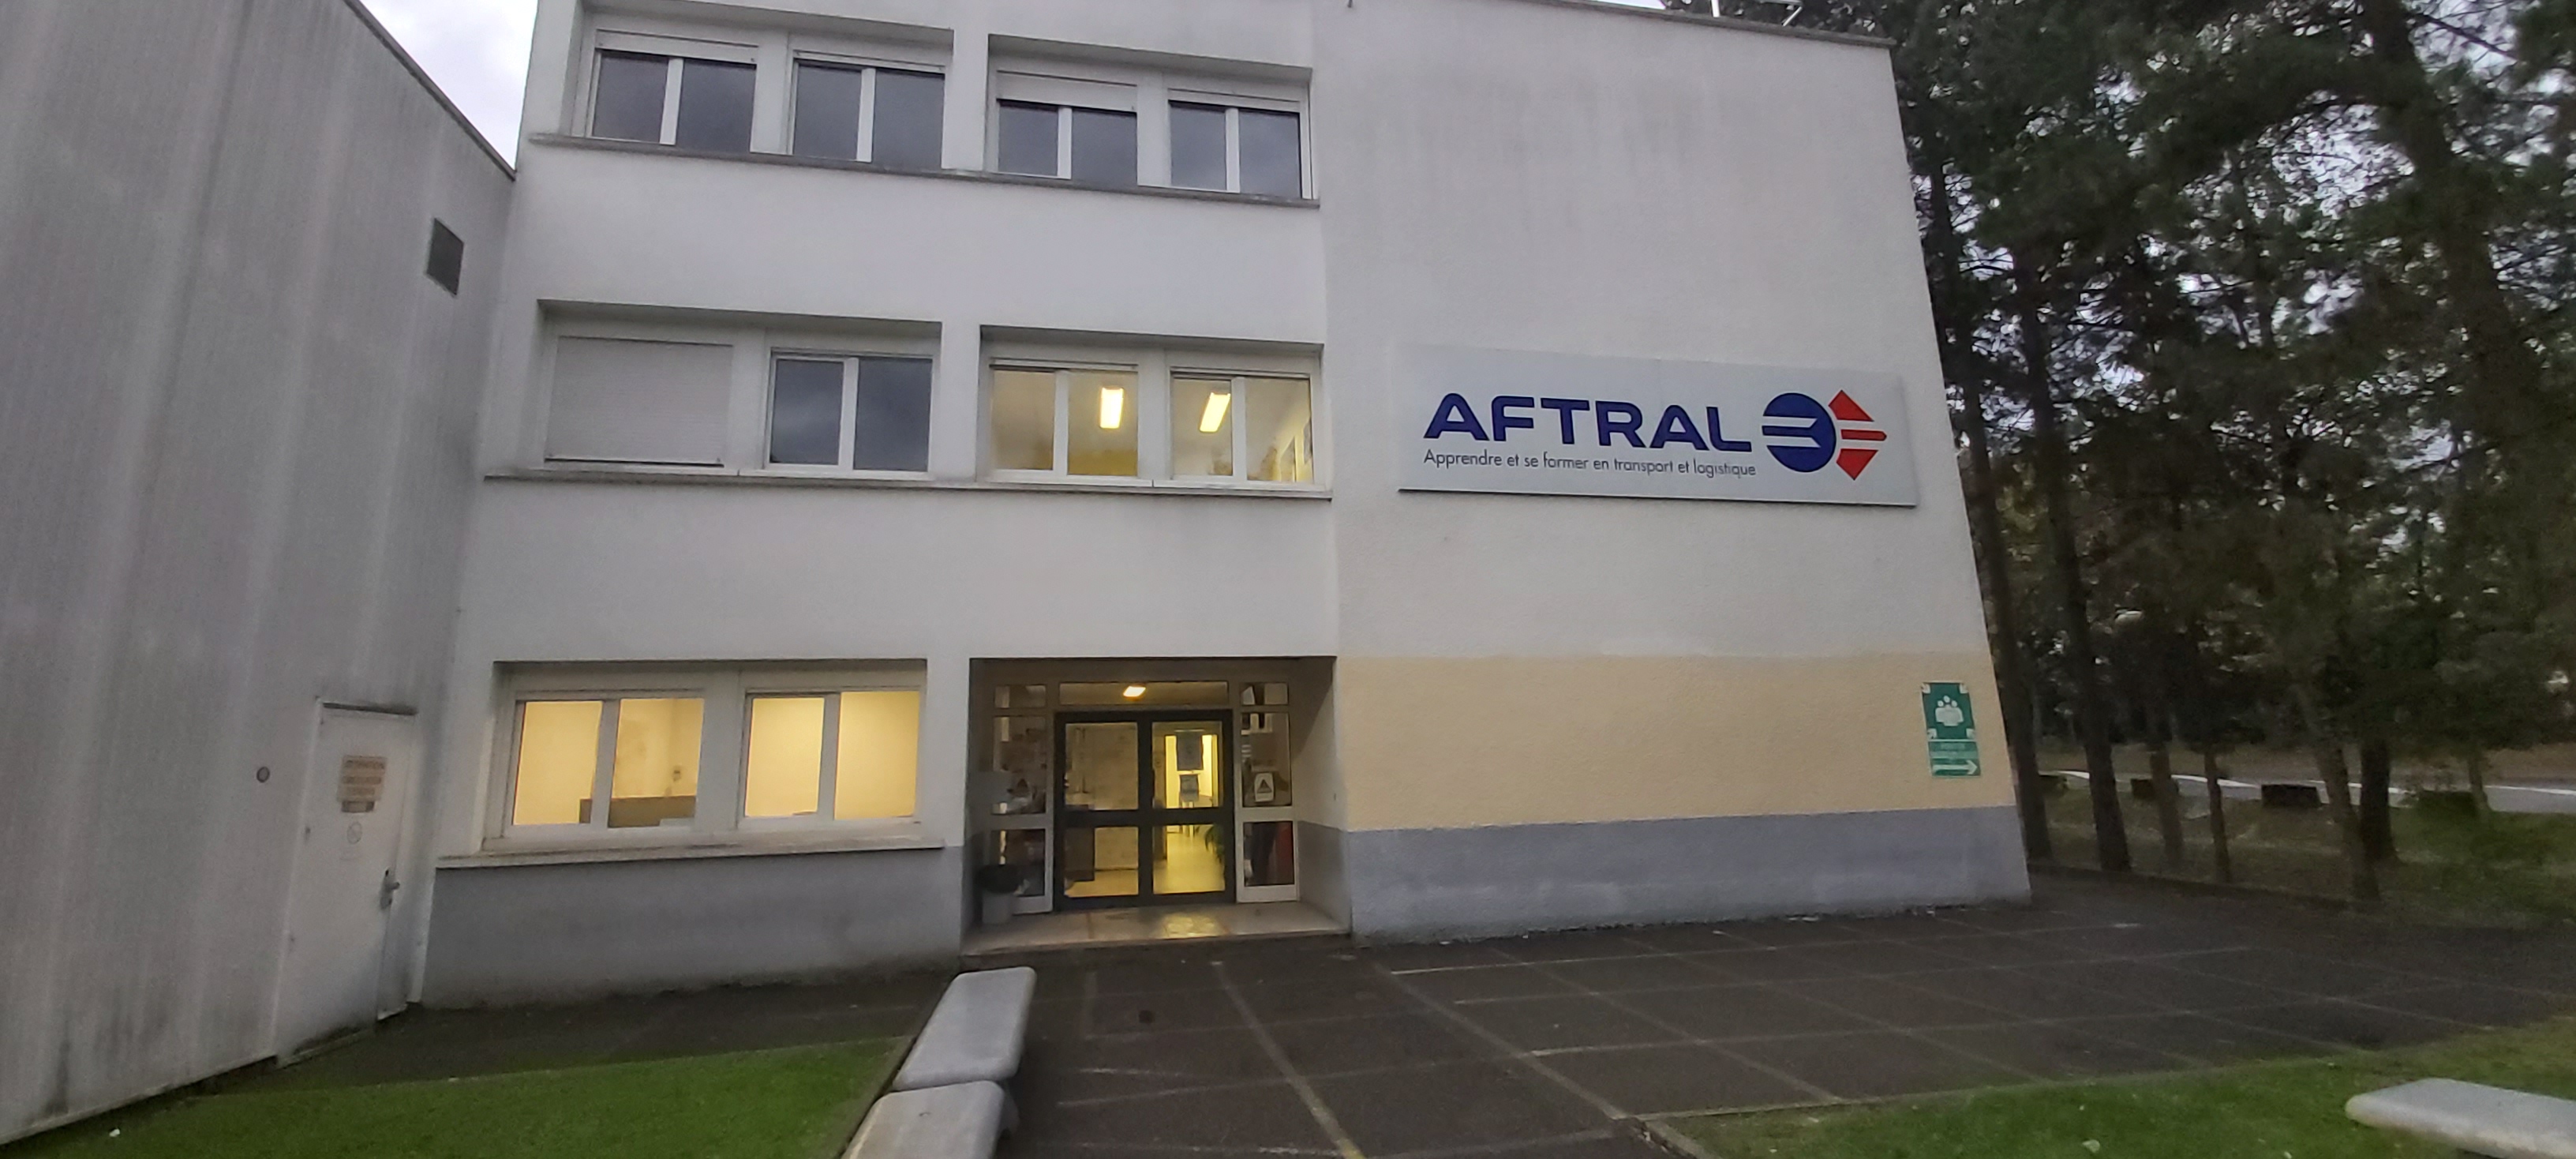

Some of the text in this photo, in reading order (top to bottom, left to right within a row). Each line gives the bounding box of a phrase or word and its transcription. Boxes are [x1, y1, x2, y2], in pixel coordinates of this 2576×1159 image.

[1423, 392, 1752, 452] AFTRAL
[1423, 448, 1757, 479] Apprendre et se former en transport et logistique
